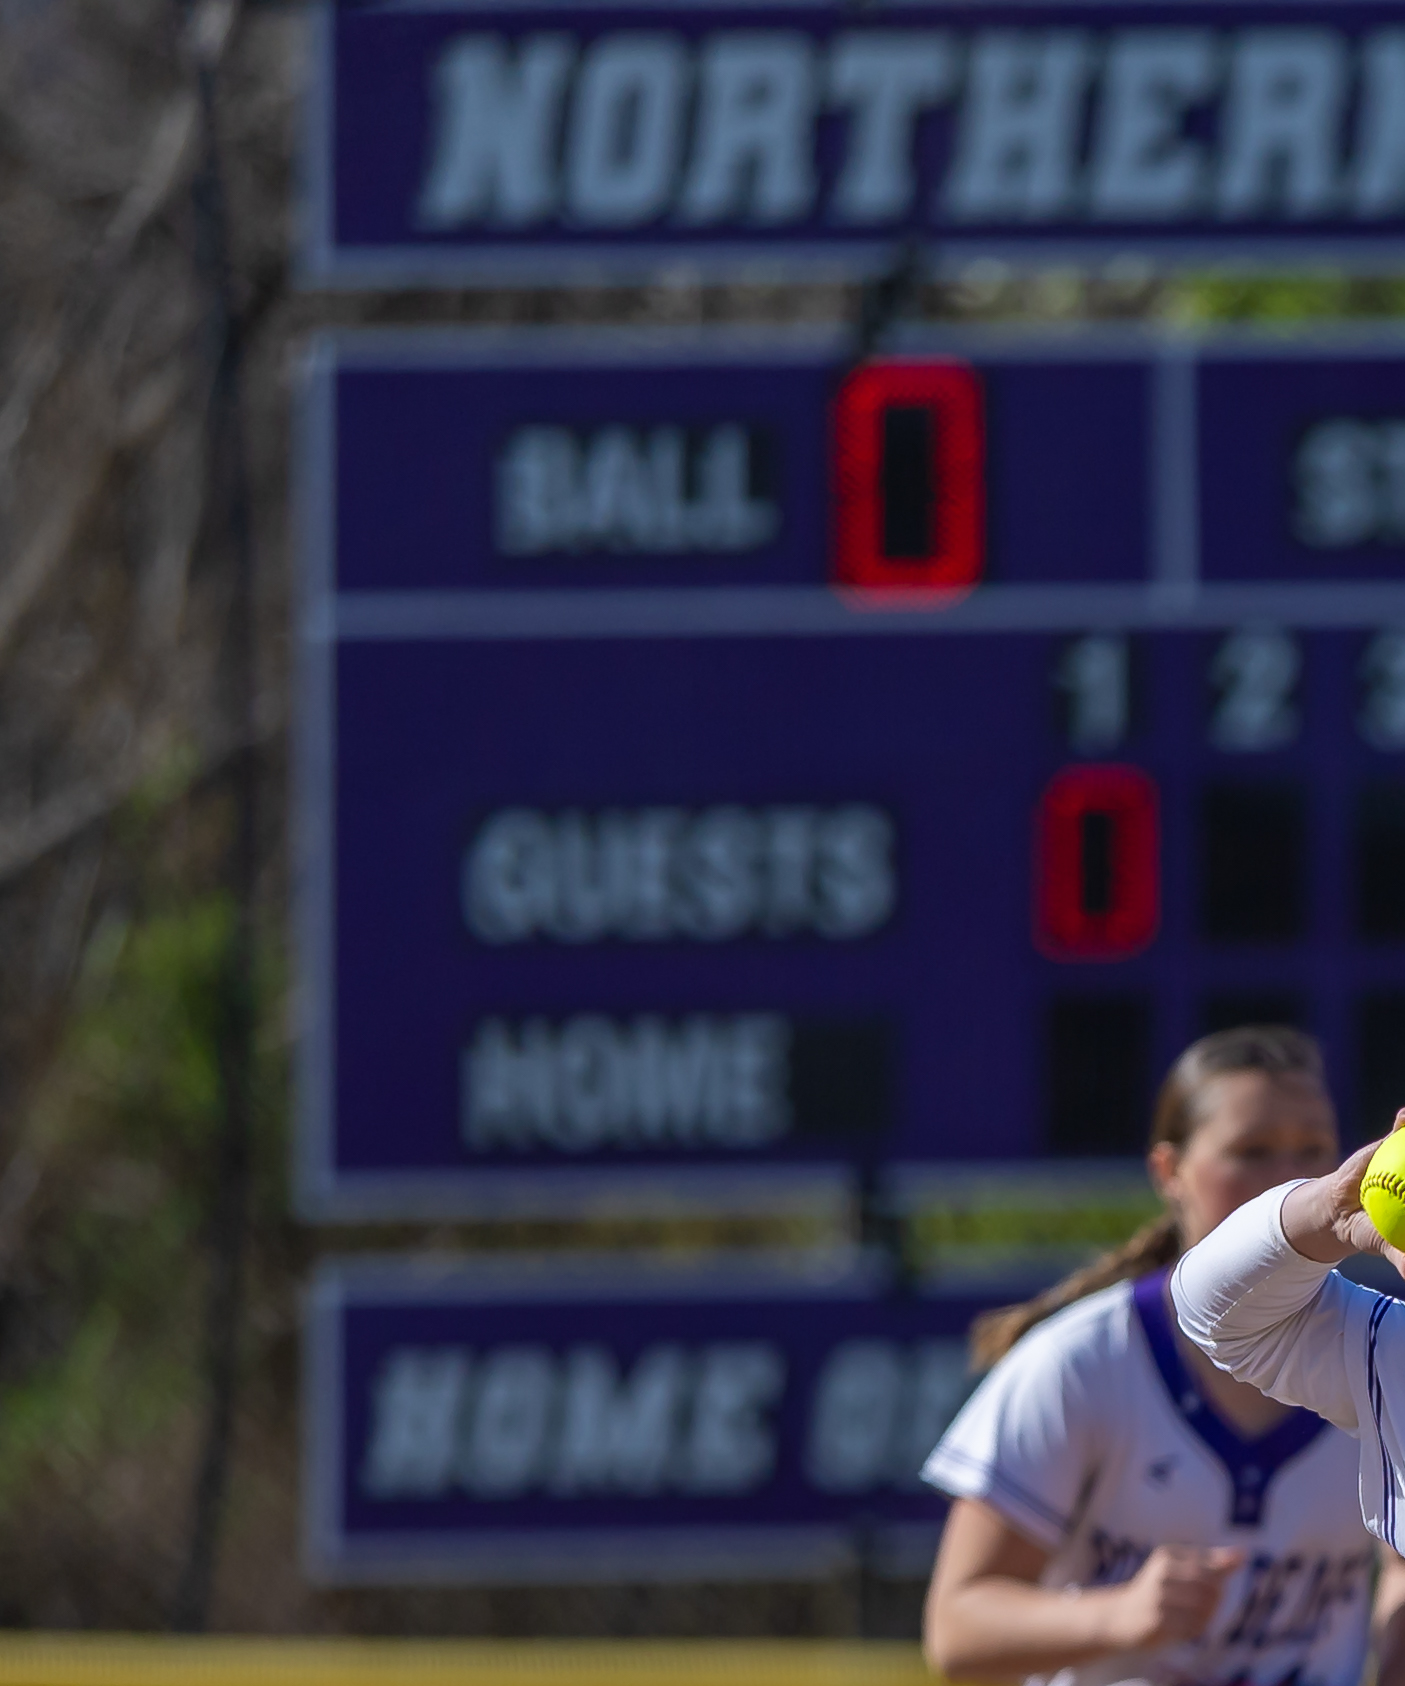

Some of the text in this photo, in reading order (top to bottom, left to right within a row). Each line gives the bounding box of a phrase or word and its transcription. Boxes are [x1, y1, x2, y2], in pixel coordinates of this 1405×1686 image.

[497, 426, 774, 554] BALL
[831, 357, 987, 609] 0
[1062, 630, 1129, 745] 1
[1215, 628, 1299, 752] 2
[464, 806, 895, 942] GUESTS
[1034, 763, 1162, 961] 0
[464, 1014, 786, 1147] HOME
[364, 1342, 784, 1494] HOME
